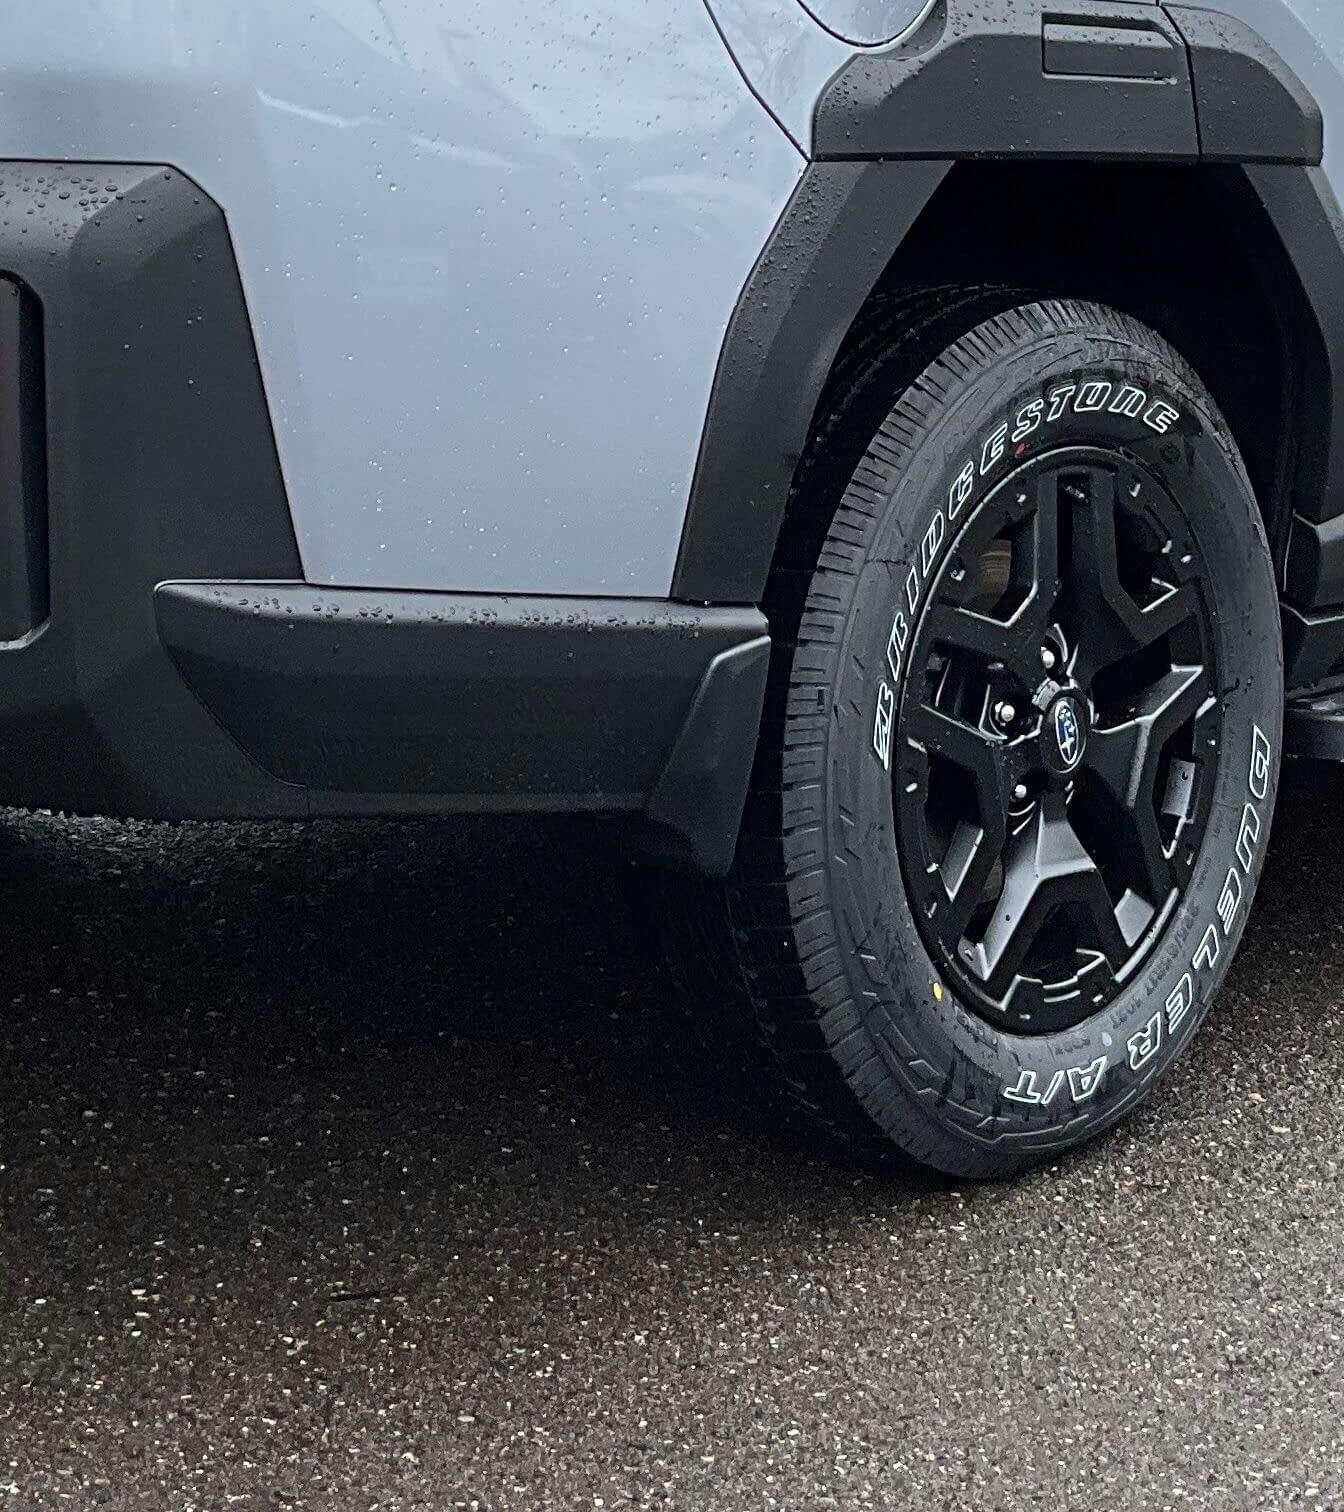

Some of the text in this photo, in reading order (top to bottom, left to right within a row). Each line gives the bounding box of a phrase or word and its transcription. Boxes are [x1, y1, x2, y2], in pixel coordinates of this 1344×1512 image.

[873, 382, 1179, 771] BRIDGESTONE
[1127, 724, 1271, 1071] DUELER
[1003, 1055, 1107, 1105] A/T
